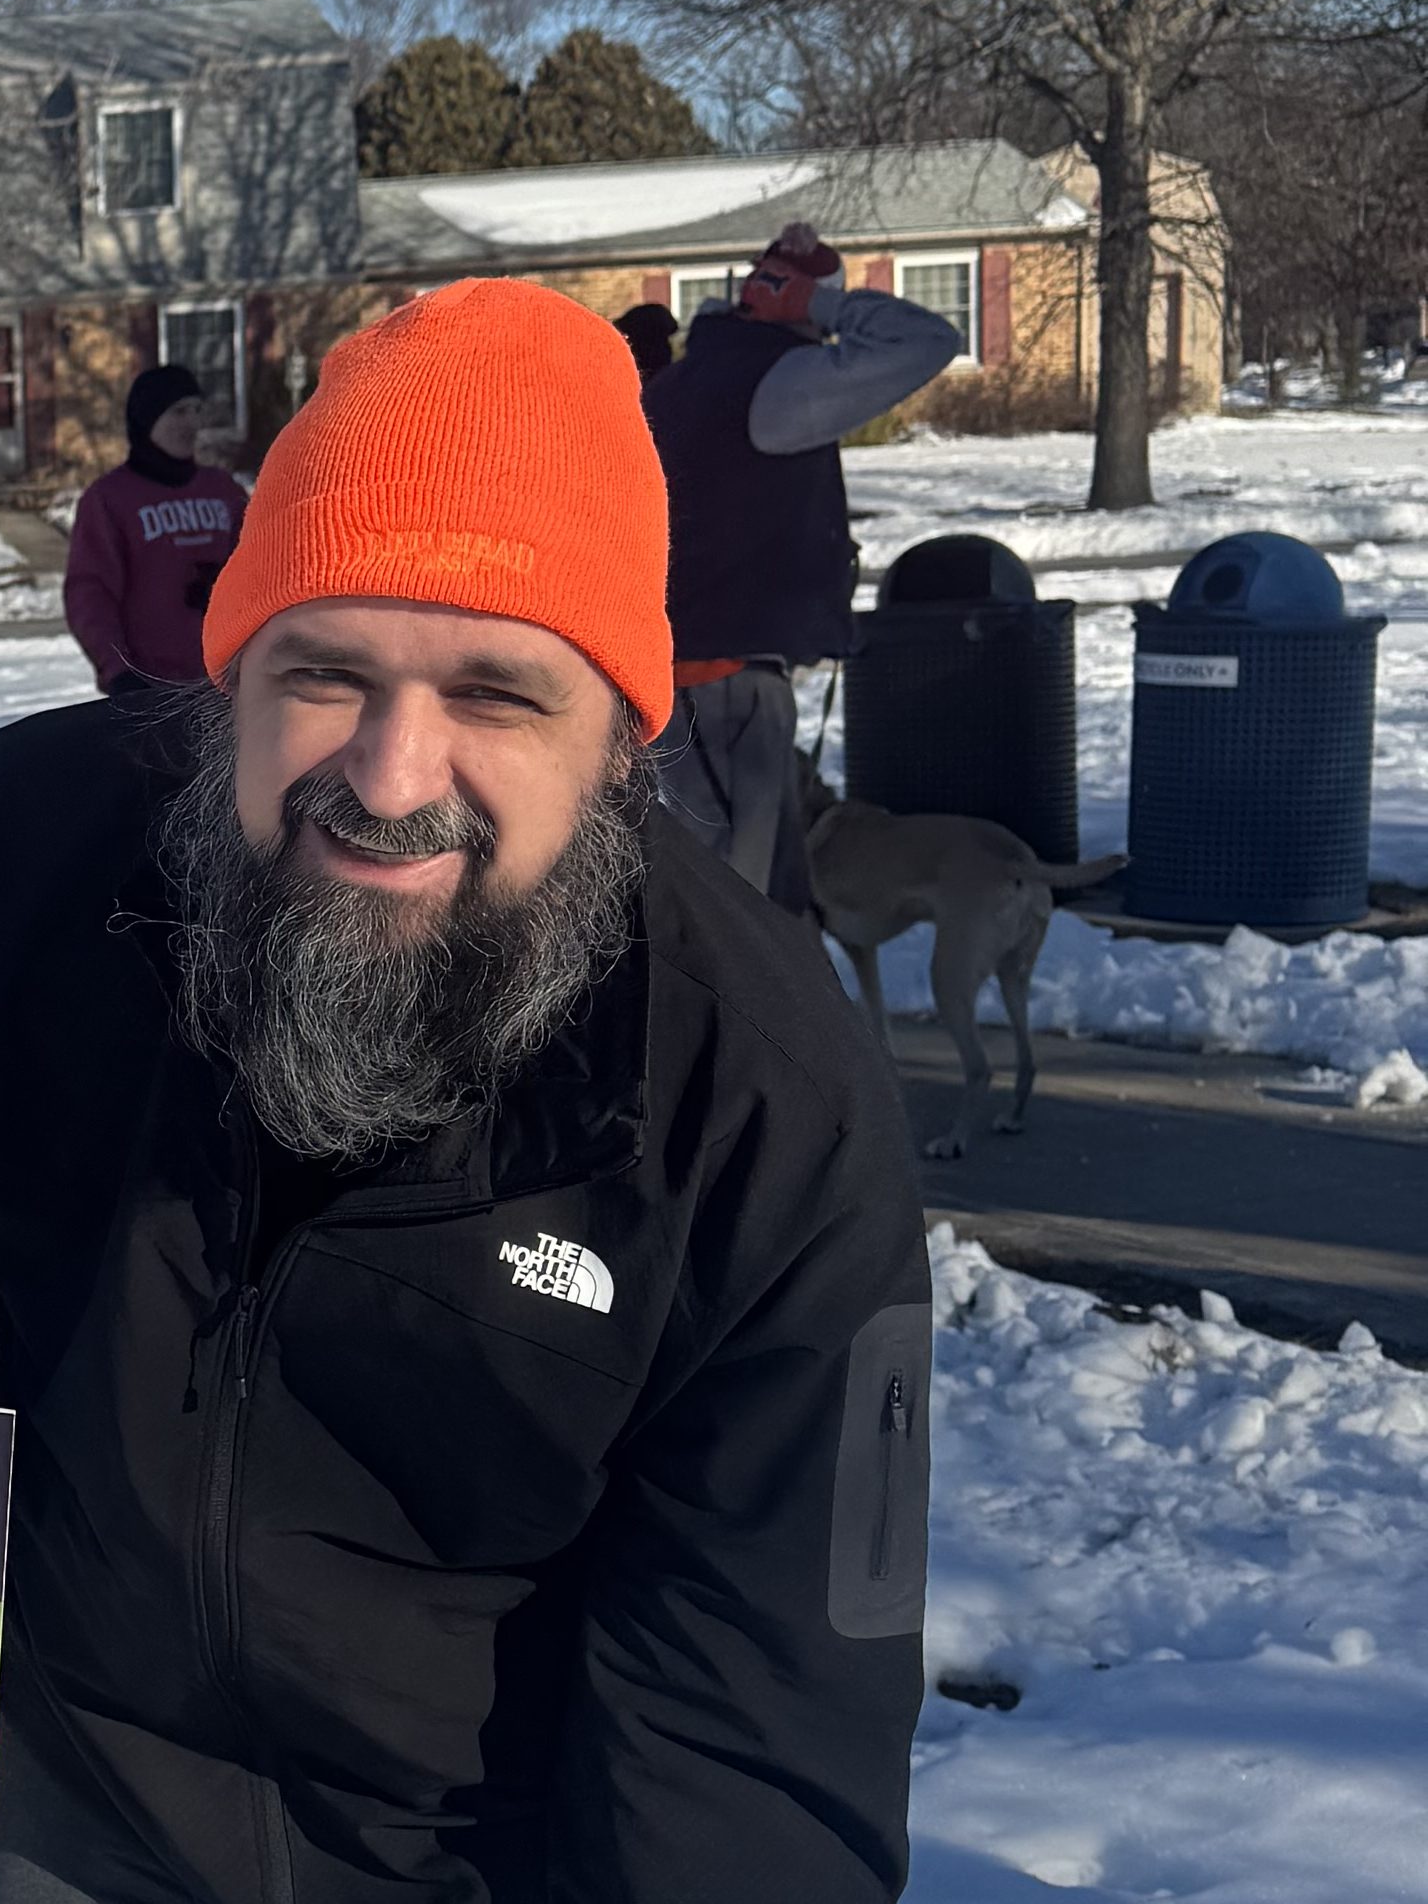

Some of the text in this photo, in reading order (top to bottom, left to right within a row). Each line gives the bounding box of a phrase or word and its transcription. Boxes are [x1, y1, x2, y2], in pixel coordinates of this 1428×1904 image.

[499, 1241, 575, 1281] NORTH
[537, 1232, 582, 1263] THE
[511, 1266, 570, 1300] FACE
